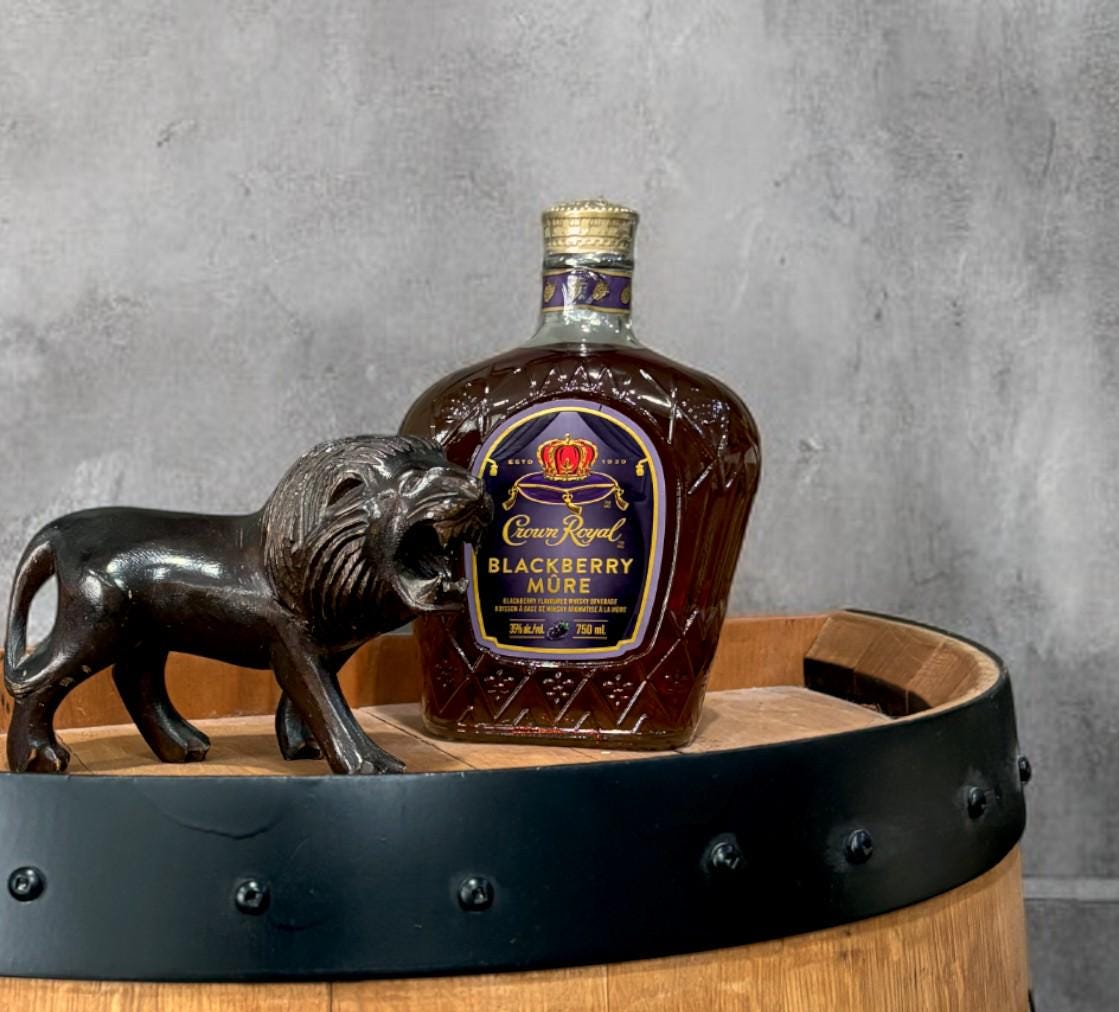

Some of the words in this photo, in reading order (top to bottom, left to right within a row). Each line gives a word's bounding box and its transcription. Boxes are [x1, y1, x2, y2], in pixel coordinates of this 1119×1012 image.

[502, 514, 559, 547] Crown
[545, 514, 627, 548] Royal
[488, 557, 634, 574] BLACKBERRY
[527, 574, 592, 594] MÛRE
[576, 624, 593, 634] 750
